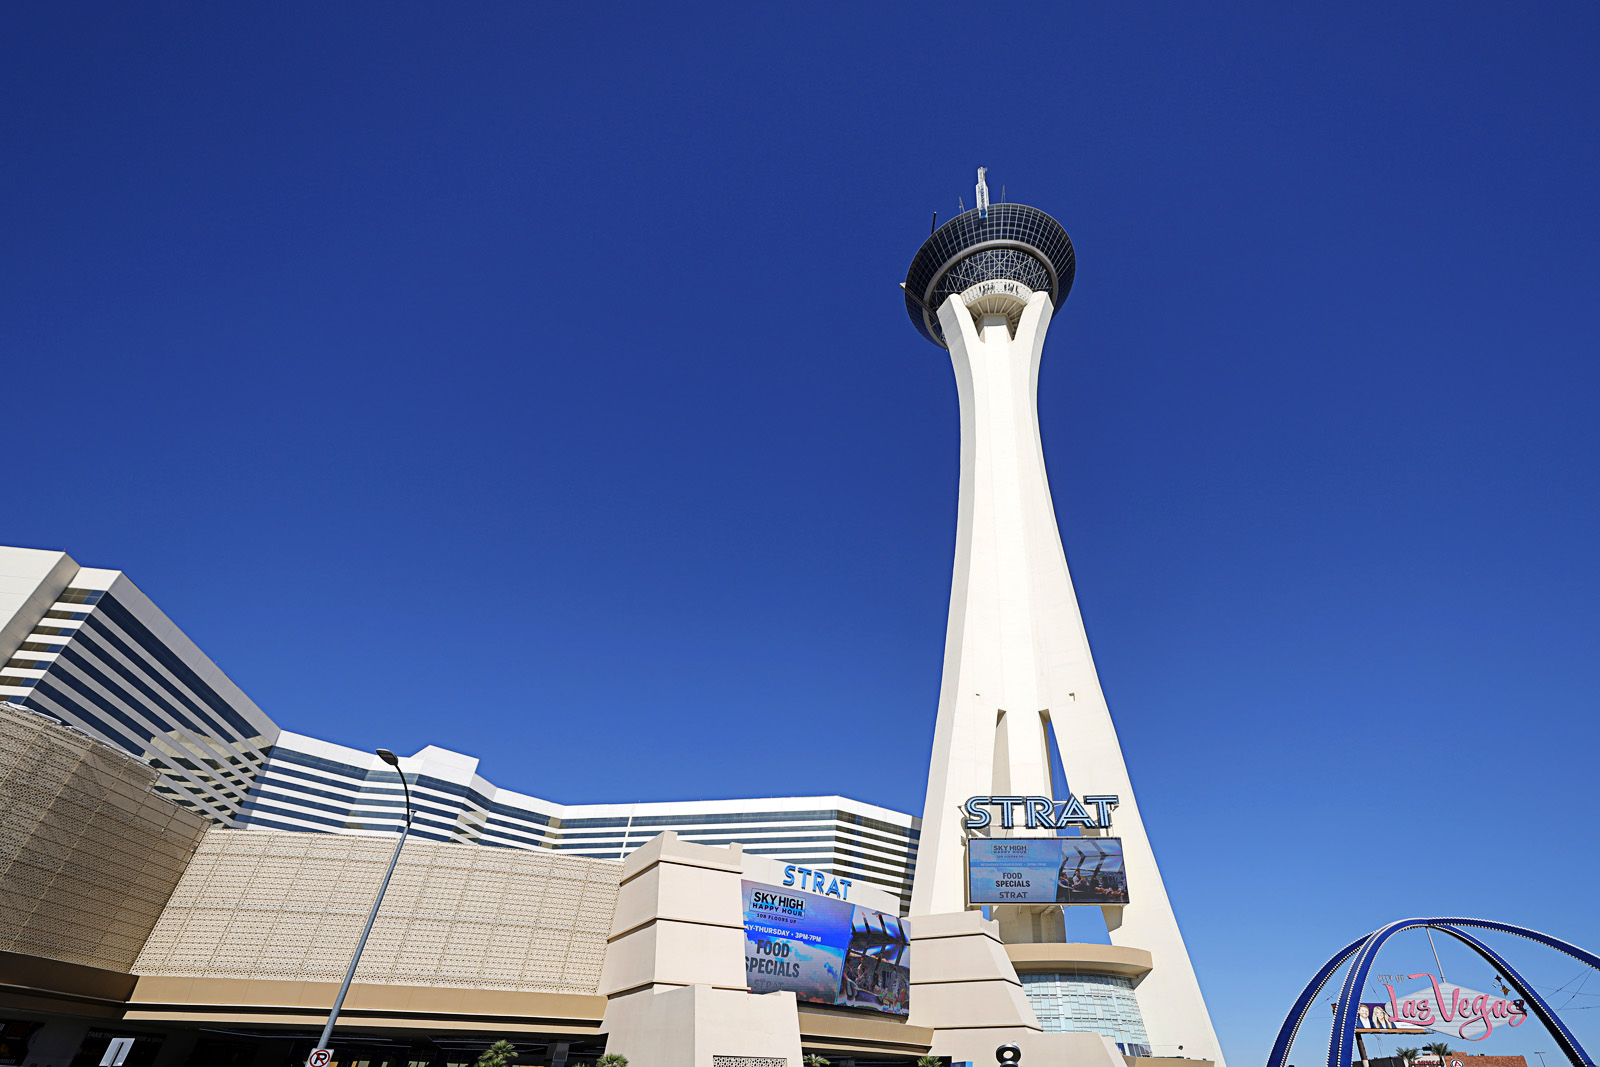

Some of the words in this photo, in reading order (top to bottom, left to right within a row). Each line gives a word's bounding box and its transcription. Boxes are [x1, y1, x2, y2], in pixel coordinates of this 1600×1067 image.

[965, 793, 1119, 829] STRAT
[782, 865, 852, 900] STRAT
[995, 880, 1031, 888] SPECIALS
[753, 892, 778, 905] SKY
[778, 896, 804, 910] HIGH
[999, 891, 1028, 899] STRAT
[752, 903, 779, 912] HAPPY
[781, 908, 803, 917] HOUR
[768, 915, 789, 923] FLOORS
[794, 932, 822, 942] 3PM-7PM
[756, 939, 790, 958] FOOD
[1377, 974, 1394, 983] CITY
[1395, 974, 1405, 982] OF
[1383, 983, 1436, 1027] Las
[1407, 973, 1527, 1041] Vegas
